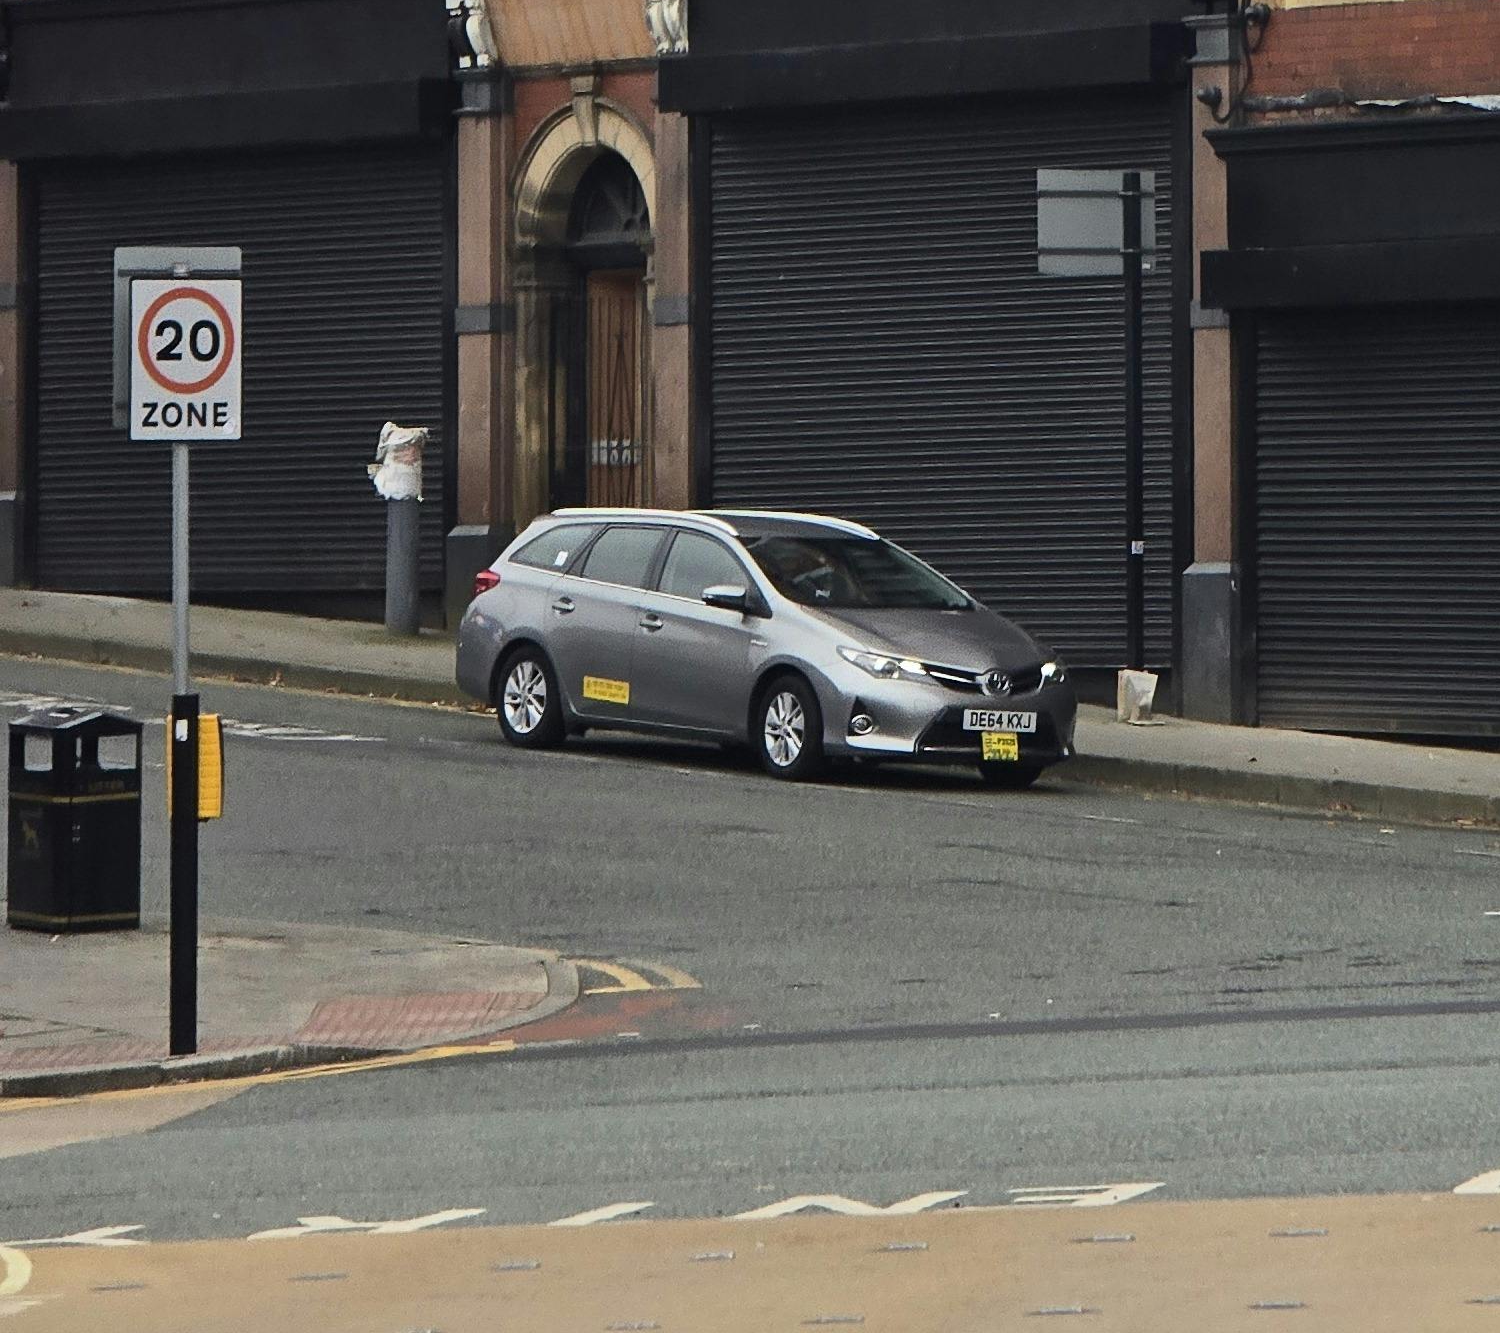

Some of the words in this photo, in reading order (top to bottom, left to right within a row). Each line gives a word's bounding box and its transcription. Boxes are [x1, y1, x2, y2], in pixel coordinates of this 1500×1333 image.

[156, 319, 221, 362] 20
[141, 401, 229, 428] ZONE
[970, 712, 1003, 727] DE64
[1007, 714, 1032, 729] KXJ
